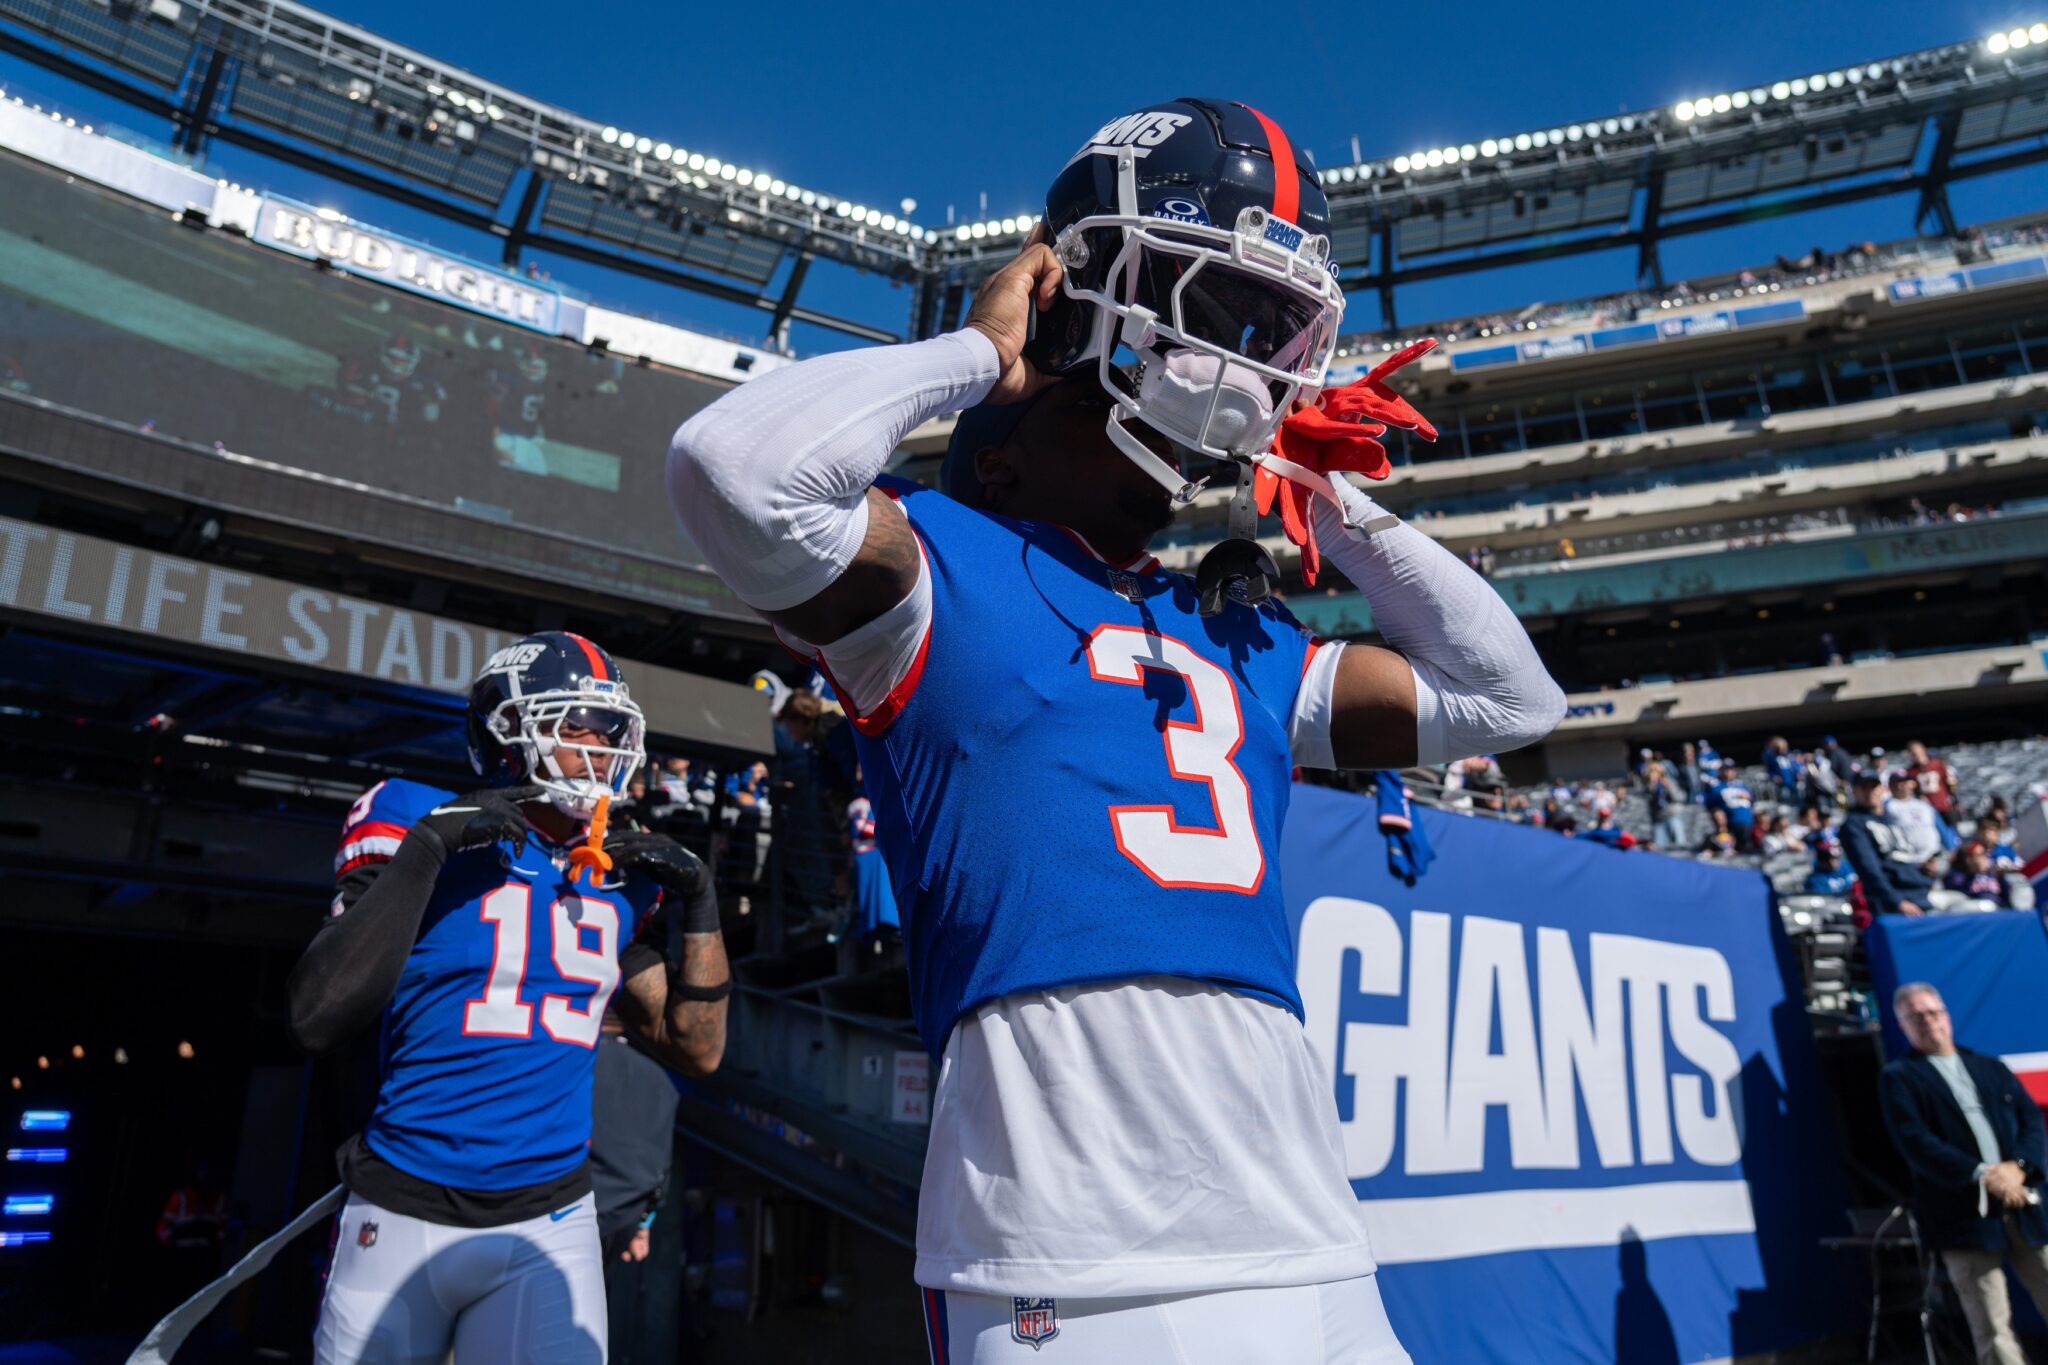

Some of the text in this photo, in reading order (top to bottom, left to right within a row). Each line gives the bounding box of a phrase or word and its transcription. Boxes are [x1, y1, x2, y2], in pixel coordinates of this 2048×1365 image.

[1091, 112, 1193, 146] ANTS
[273, 208, 545, 324] BUD LIGHT
[1264, 217, 1304, 252] GIANTS
[1891, 528, 2010, 561] MetLife
[0, 519, 501, 692] TLIFE STADI
[1083, 623, 1266, 896] 3
[462, 881, 622, 1049] 19
[1296, 896, 1745, 1180] GIANTS
[1020, 1311, 1052, 1336] NFL
